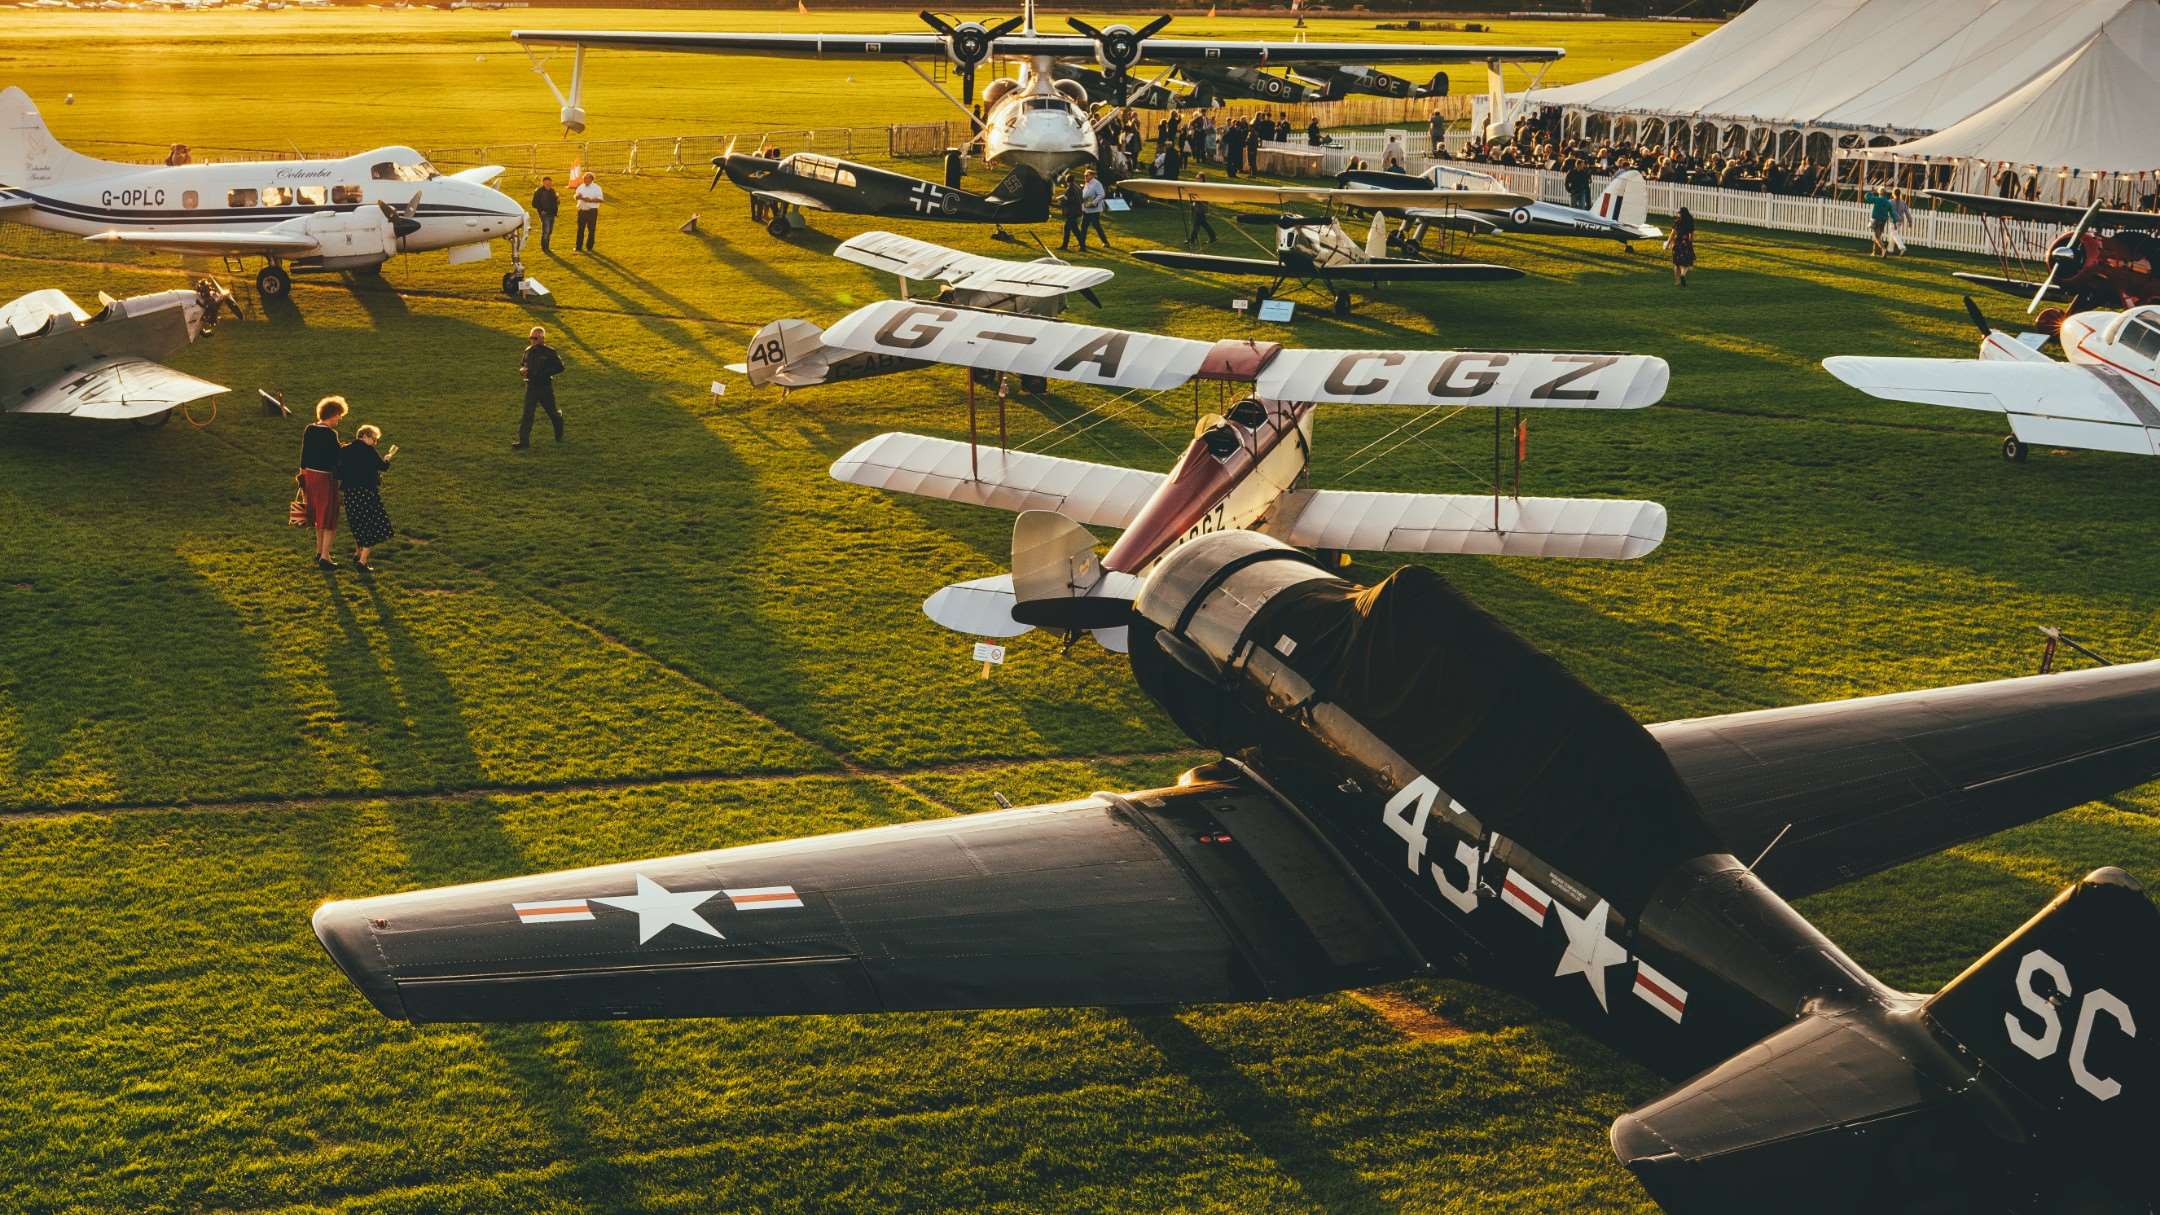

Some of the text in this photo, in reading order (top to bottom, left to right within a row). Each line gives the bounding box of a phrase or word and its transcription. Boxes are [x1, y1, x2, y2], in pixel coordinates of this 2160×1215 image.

[102, 189, 165, 206] G-OPLC
[751, 340, 785, 366] 48
[1382, 774, 1500, 914] 43
[2004, 949, 2137, 1101] SC
